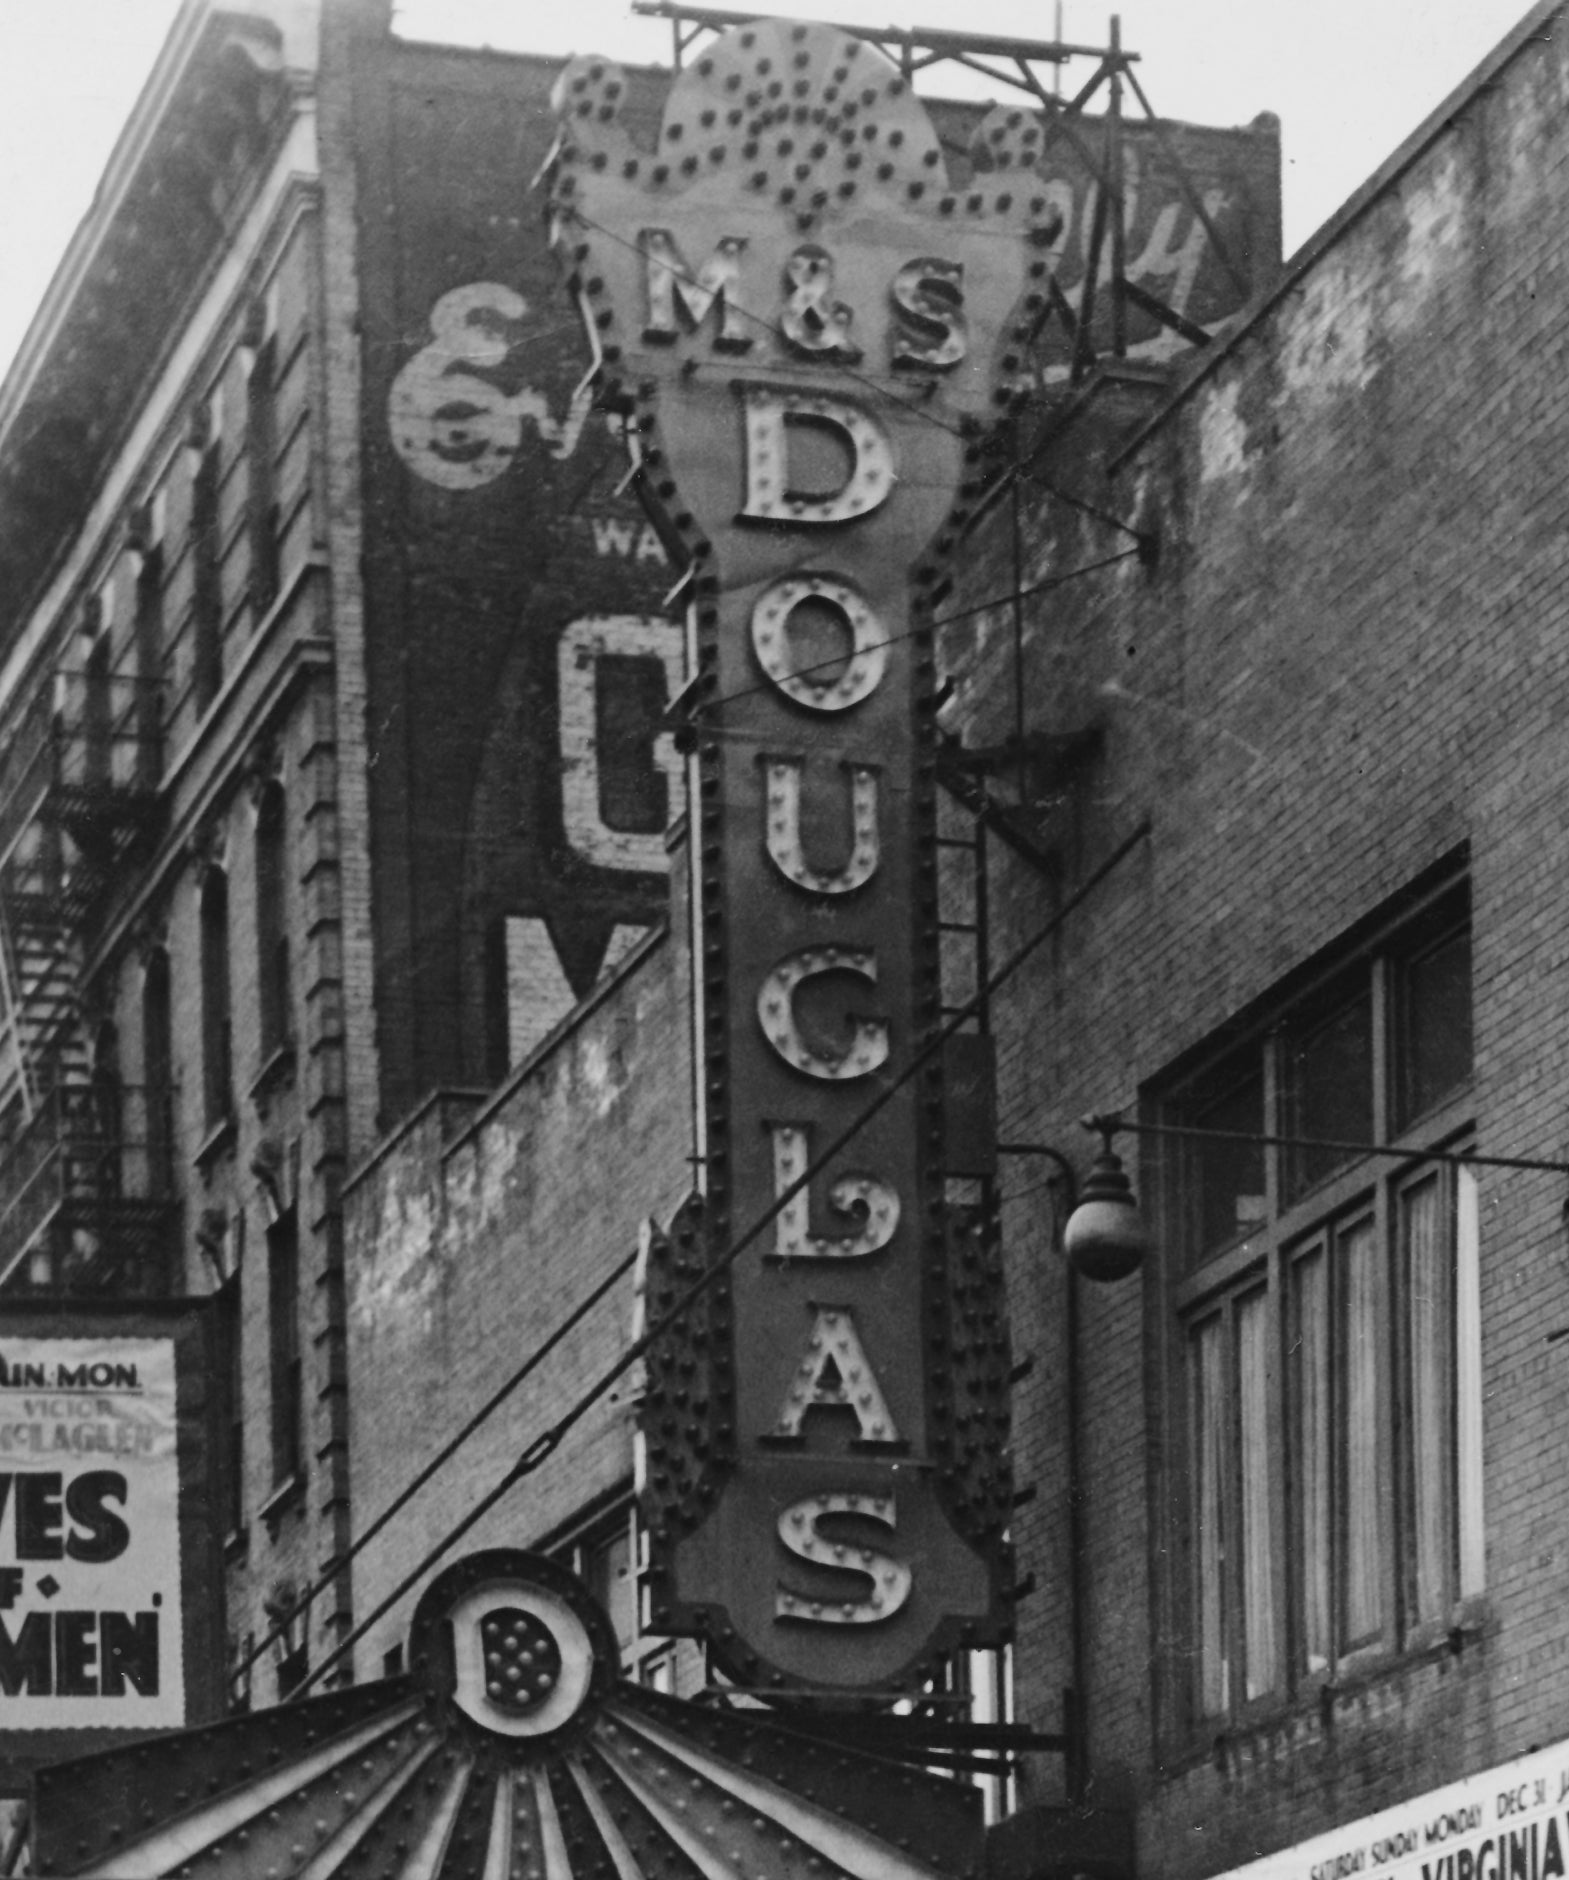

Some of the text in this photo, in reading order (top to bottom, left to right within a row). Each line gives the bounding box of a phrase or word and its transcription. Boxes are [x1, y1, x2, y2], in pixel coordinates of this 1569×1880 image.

[636, 228, 966, 371] M & S
[729, 377, 914, 1626] DOUGLAS
[1371, 1829, 1418, 1866] SUNDAY
[1424, 1804, 1482, 1844] MONDAY
[1496, 1784, 1528, 1820] DEC
